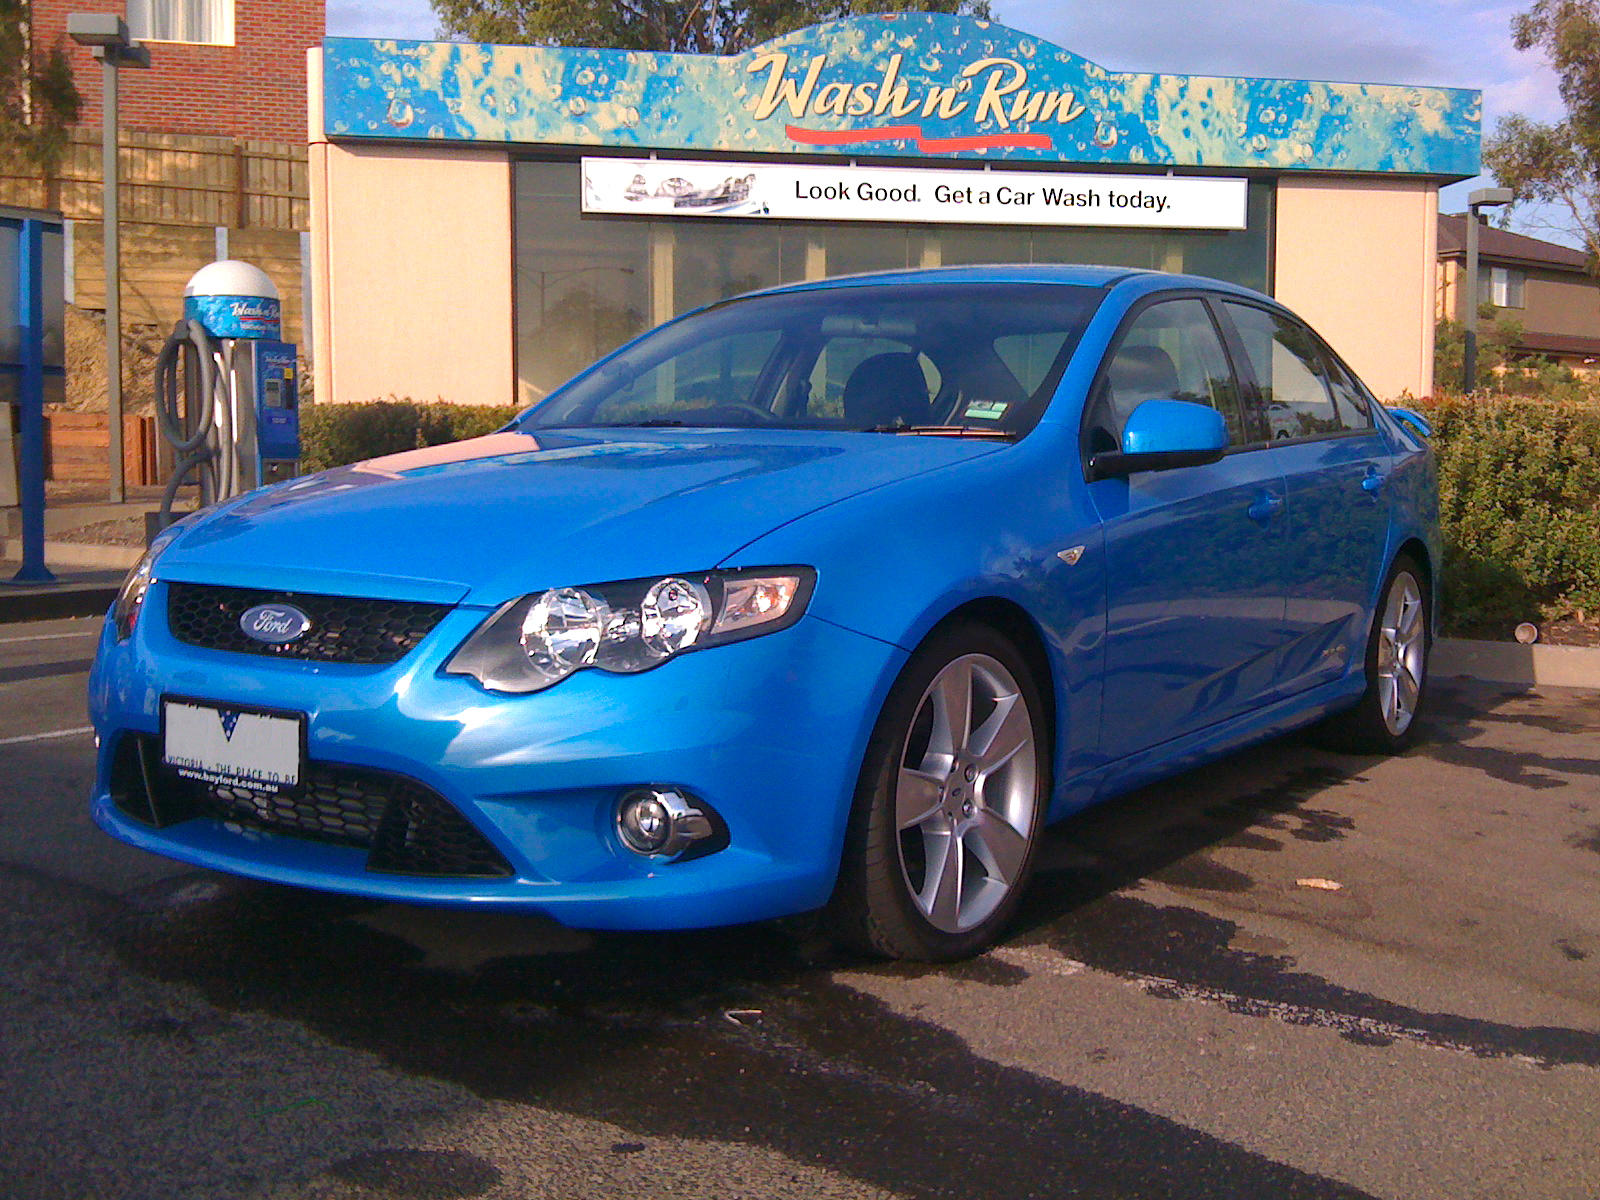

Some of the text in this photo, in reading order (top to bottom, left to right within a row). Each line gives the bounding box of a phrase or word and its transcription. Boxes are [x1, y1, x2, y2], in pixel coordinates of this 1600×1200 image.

[746, 53, 921, 121] Wash
[962, 57, 1086, 129] Run
[795, 180, 1172, 213] Look Good. Get a Car Wash today.
[253, 609, 294, 635] Ford
[215, 762, 231, 776] THE
[236, 766, 262, 780] PLACE
[268, 771, 280, 783] TO
